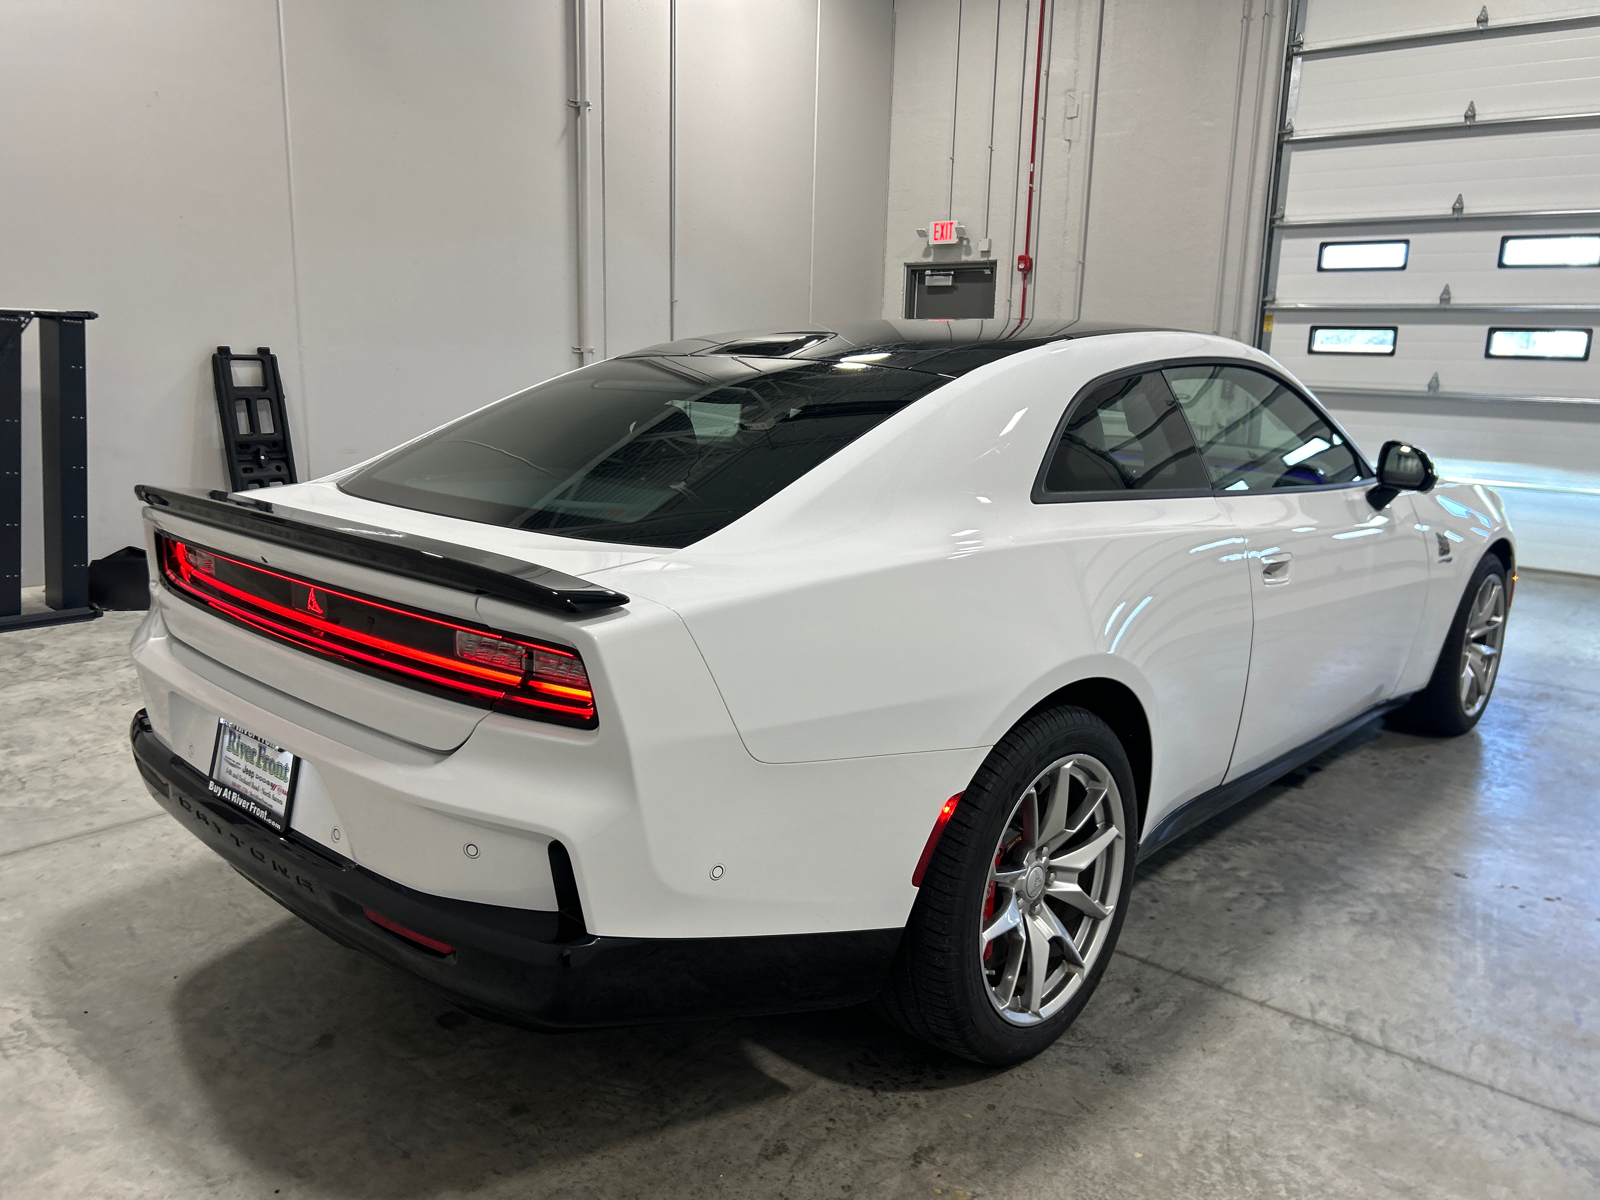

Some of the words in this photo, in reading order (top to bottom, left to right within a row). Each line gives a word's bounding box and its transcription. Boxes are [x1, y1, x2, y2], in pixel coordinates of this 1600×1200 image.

[933, 222, 954, 241] EXIT
[227, 729, 257, 764] River
[242, 765, 255, 779] Jeep
[208, 781, 223, 797] Buy
[222, 788, 232, 800] At
[178, 796, 316, 895] DAYTONA
